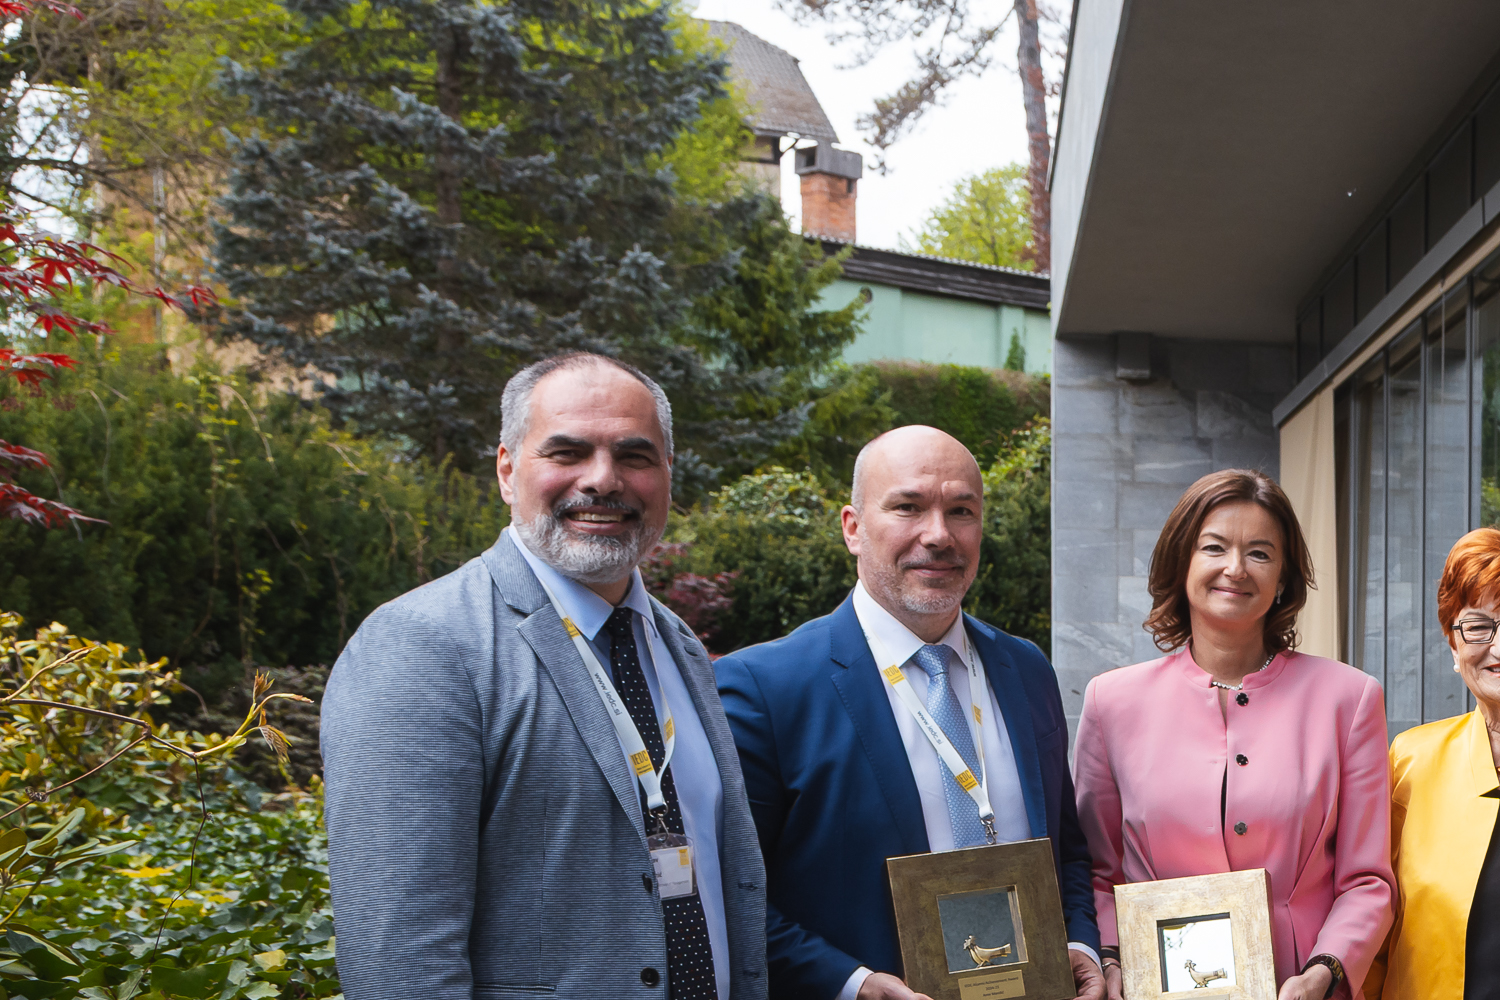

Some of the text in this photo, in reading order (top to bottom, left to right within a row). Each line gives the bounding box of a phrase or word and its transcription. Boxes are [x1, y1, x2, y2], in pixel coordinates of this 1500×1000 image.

[594, 672, 623, 716] www.iedc.si
[917, 710, 944, 746] www.iedc.si
[631, 750, 649, 766] IEDC
[956, 769, 972, 784] IEDC
